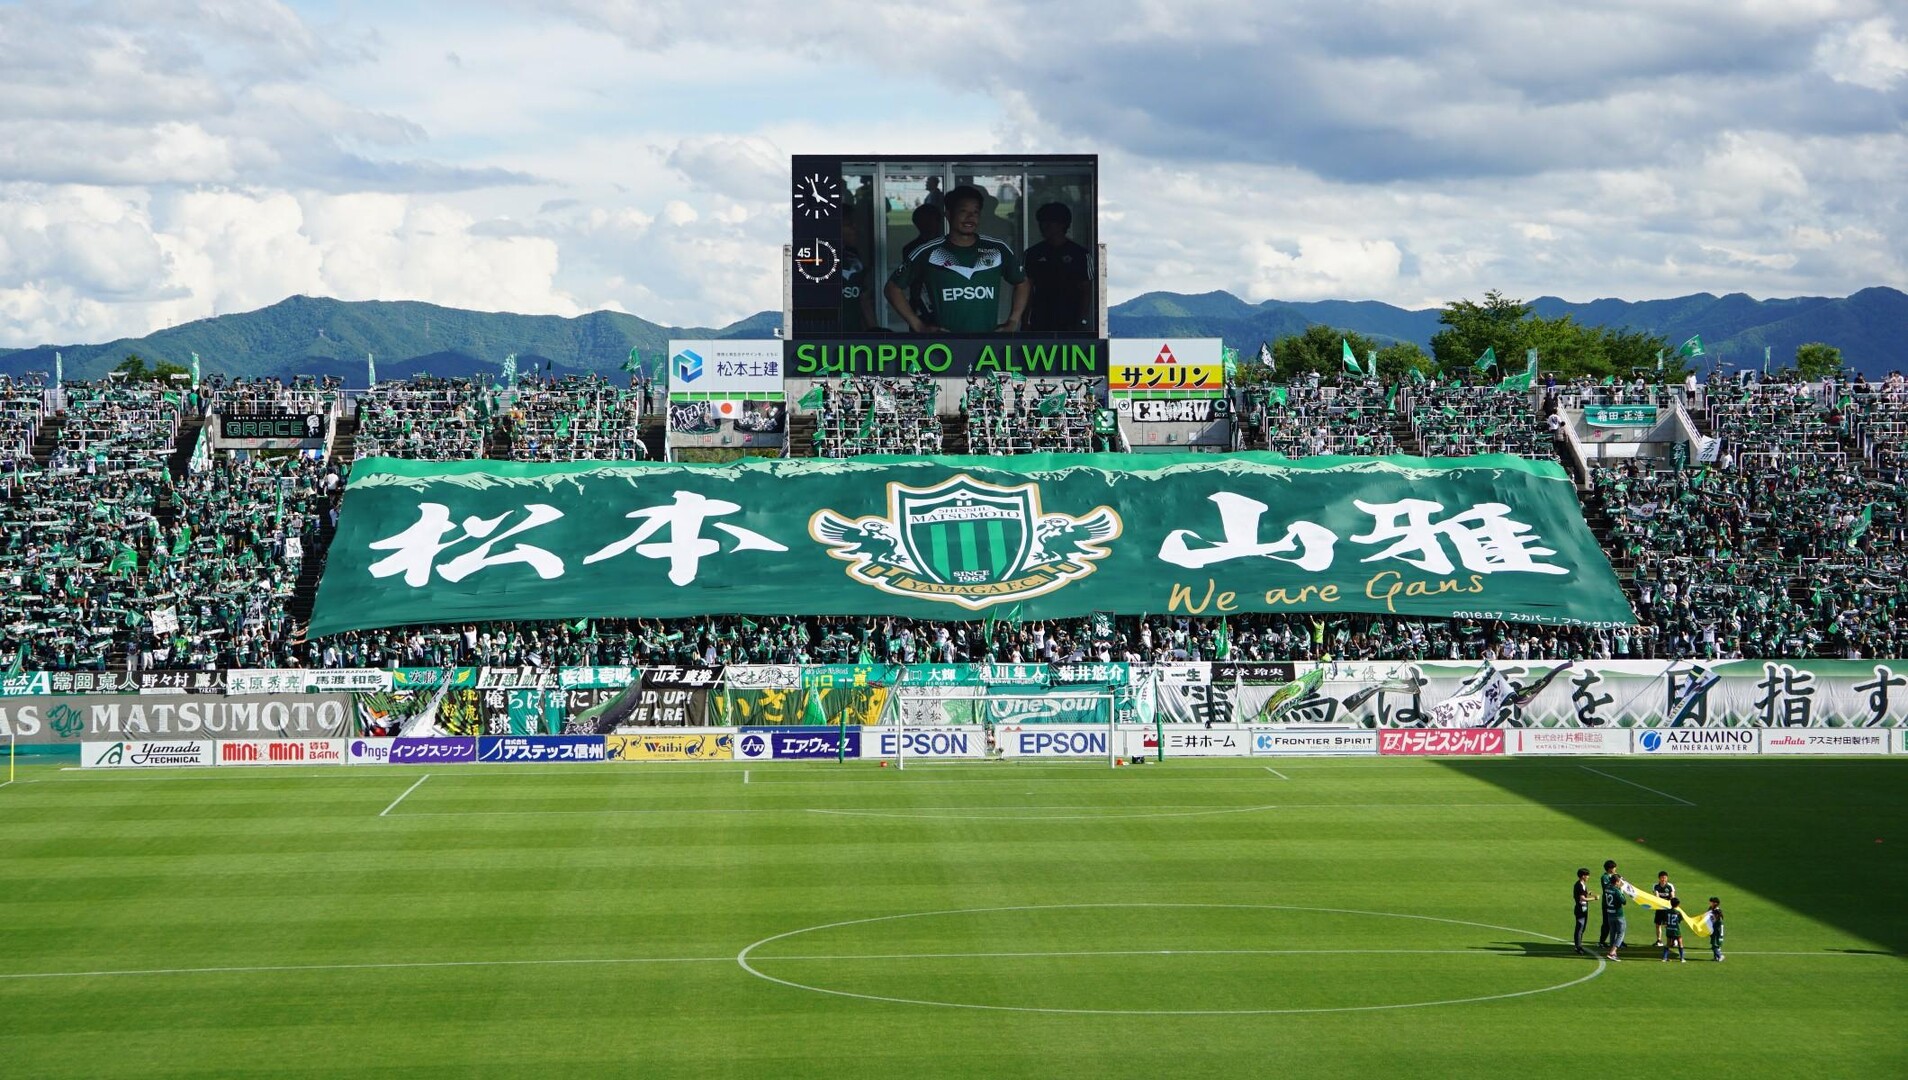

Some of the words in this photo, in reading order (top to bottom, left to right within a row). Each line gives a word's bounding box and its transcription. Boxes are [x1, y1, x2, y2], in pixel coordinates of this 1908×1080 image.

[797, 248, 811, 258] 45
[942, 286, 995, 301] EPSON
[974, 344, 1096, 372] ALWIN
[716, 361, 779, 377] 松本土建
[1121, 367, 1211, 388] サンリン
[226, 421, 304, 437] GRACE
[938, 505, 991, 513] SHINSHU
[912, 510, 1020, 523] MATSUMOTO
[368, 490, 790, 587] 松本
[1158, 490, 1571, 576] 山雅
[953, 569, 990, 578] SINCE
[911, 580, 1003, 594] YAMAGA
[1168, 578, 1239, 615] We
[1264, 582, 1342, 605] are
[1452, 610, 1503, 620] 2016.8.7
[141, 672, 190, 688] 野々村
[652, 670, 681, 683] 山本
[1058, 664, 1125, 682] 菊井悠介
[664, 691, 693, 705] UP!
[90, 701, 344, 735] MATSUMOTO
[880, 733, 968, 755] EPSON
[1019, 732, 1107, 754] EPSON
[1170, 735, 1236, 748] 三井ホーム
[1401, 731, 1501, 752] トラビスジャパン
[1666, 730, 1753, 744] AZUMINO
[1808, 736, 1880, 745] アスミ村田製作所
[131, 741, 201, 764] Yamada
[392, 743, 474, 758] イングスシナノ
[504, 743, 604, 759] アステップ信州
[644, 742, 682, 753] Waibi
[149, 756, 201, 764] TECHNICAL
[309, 751, 339, 760] BANK
[1605, 893, 1615, 907] 12
[1667, 913, 1678, 925] 12
